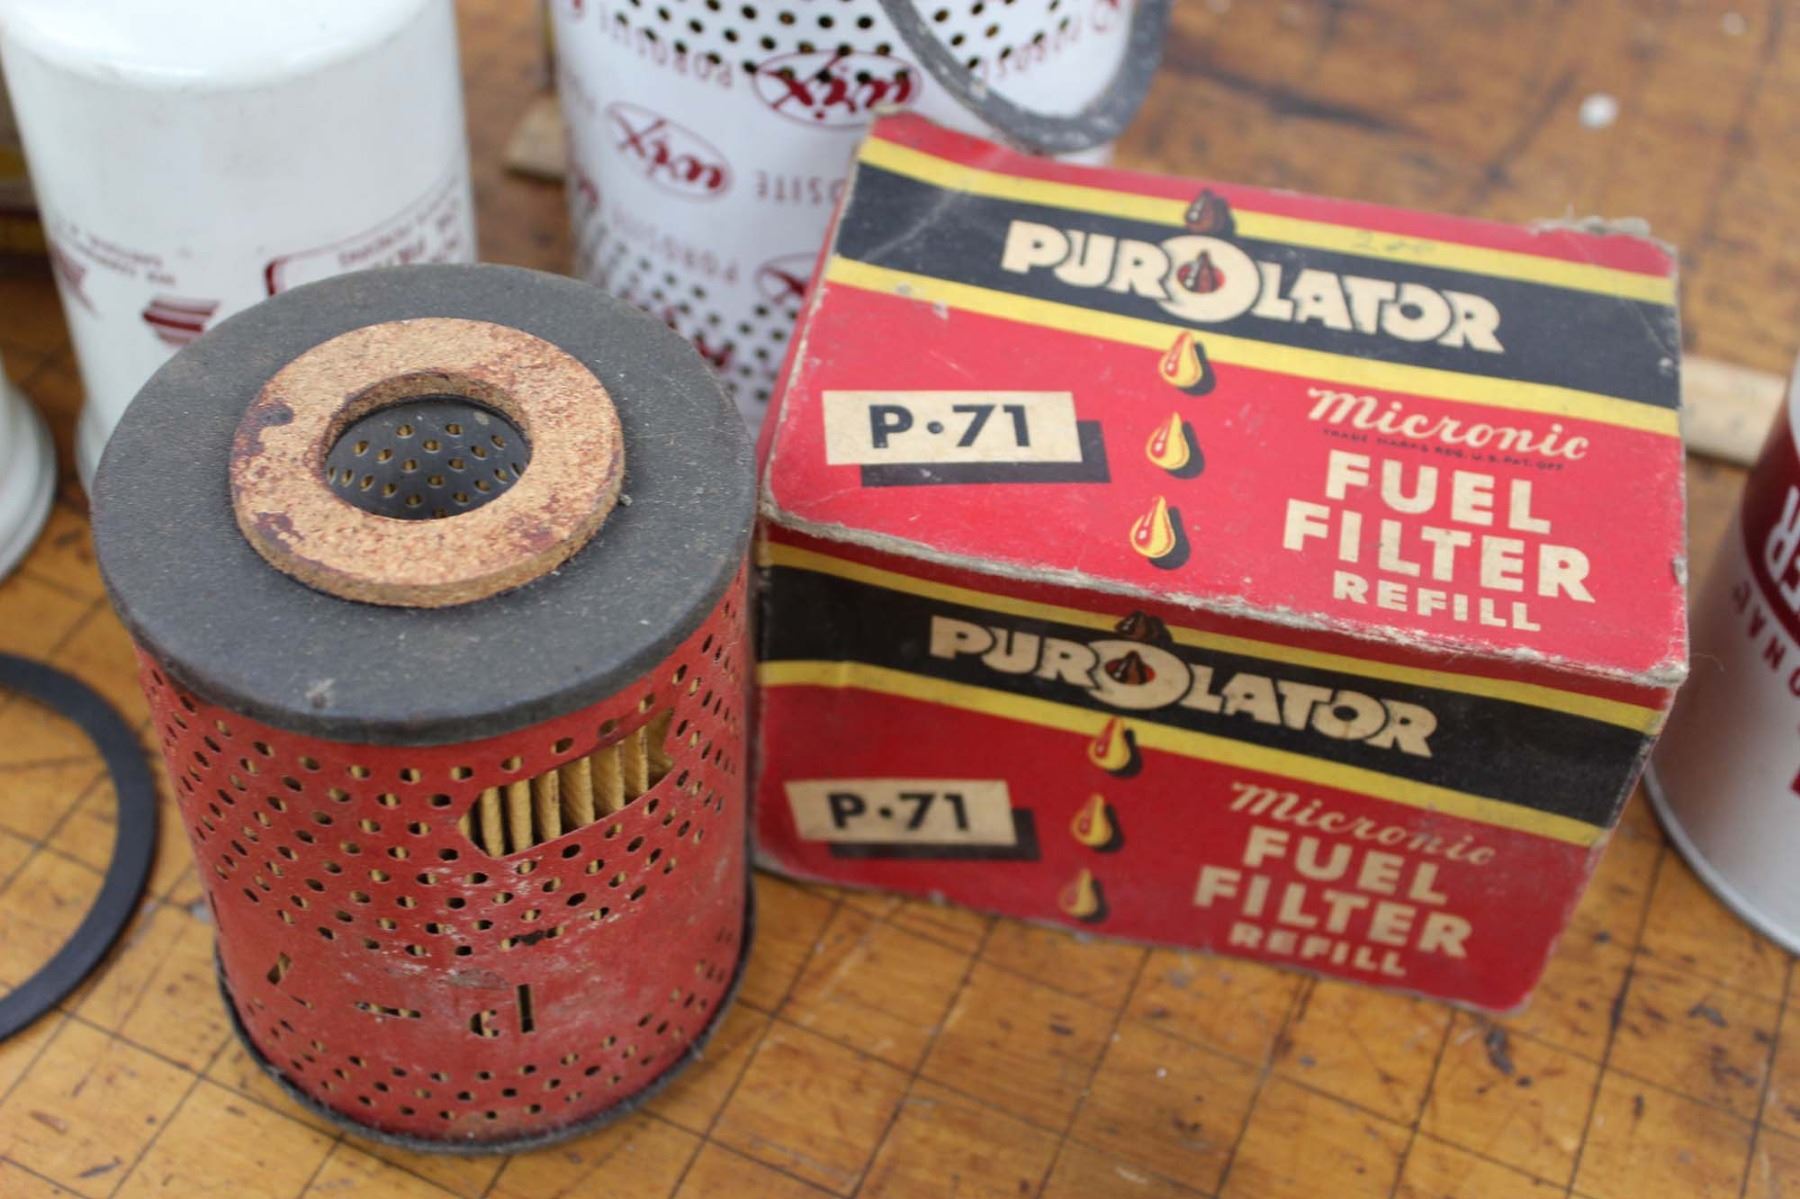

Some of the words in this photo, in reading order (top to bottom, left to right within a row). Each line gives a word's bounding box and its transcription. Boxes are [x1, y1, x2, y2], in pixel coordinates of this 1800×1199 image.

[1002, 219, 1505, 353] PUROLATOR
[1325, 449, 1551, 535] FUEL
[1282, 497, 1597, 604] FILTER
[1332, 569, 1542, 632] REFILL
[928, 614, 1438, 759] PUROLATOR
[1242, 825, 1448, 905] FUEL
[1193, 864, 1473, 959] FILTER
[1228, 923, 1407, 977] REFILL
